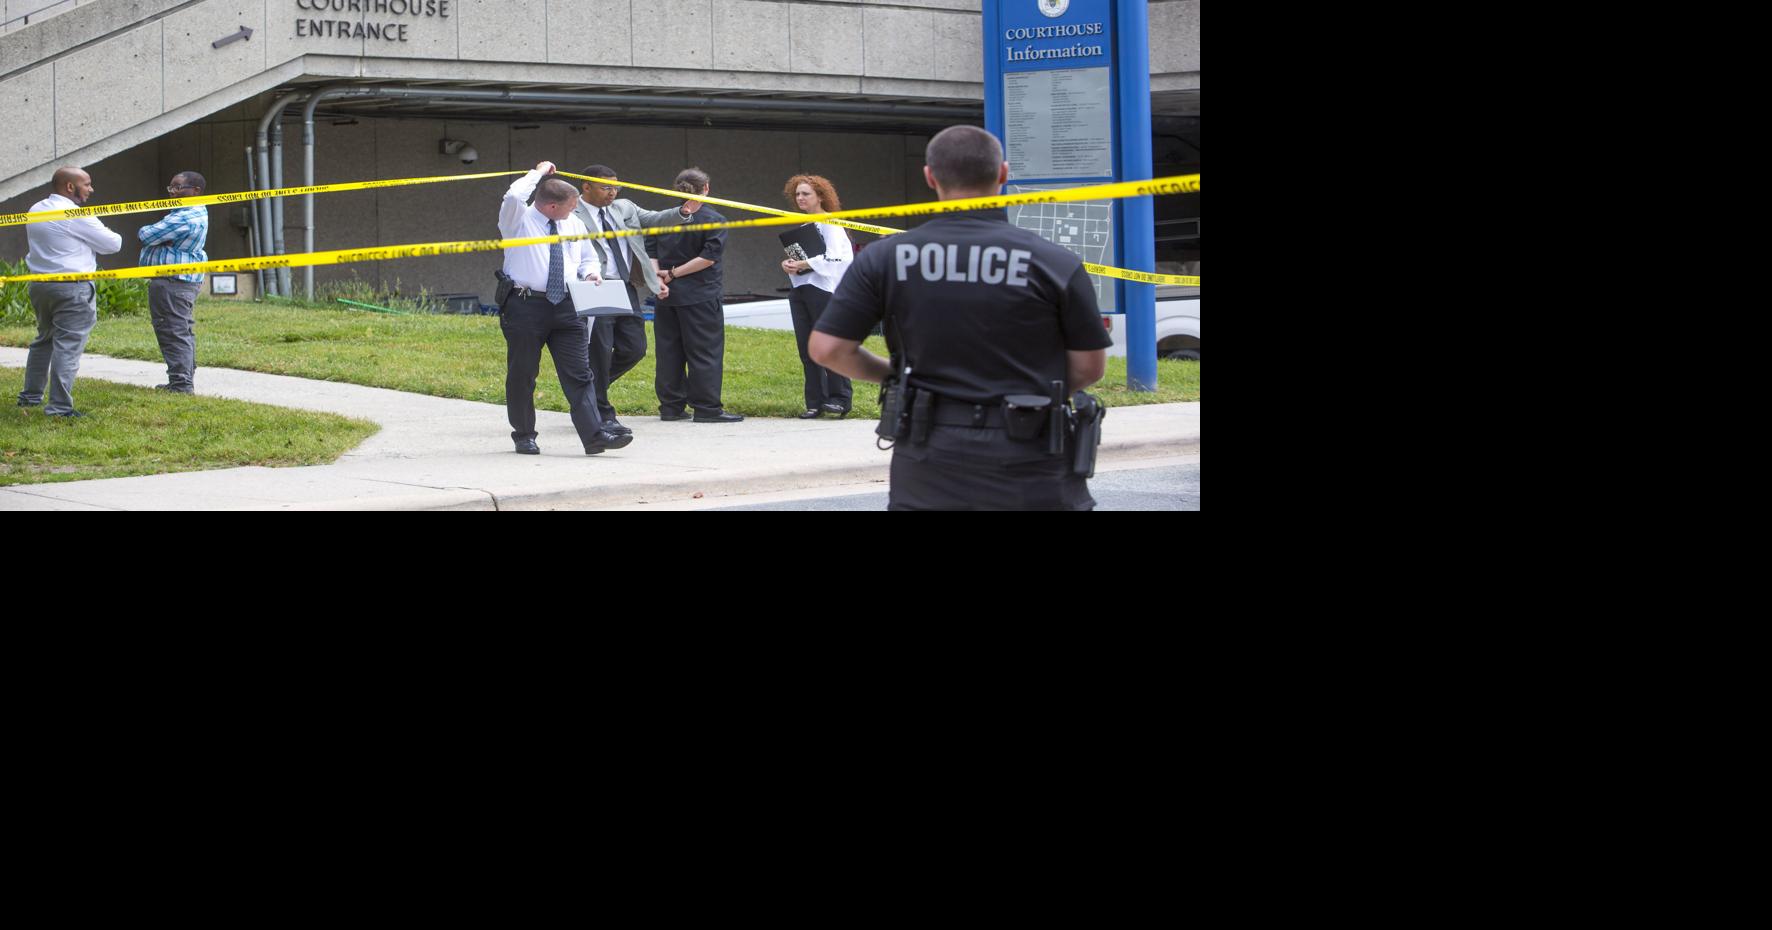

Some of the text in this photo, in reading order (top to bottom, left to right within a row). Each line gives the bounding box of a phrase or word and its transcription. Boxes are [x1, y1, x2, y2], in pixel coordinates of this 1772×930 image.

[296, 19, 408, 42] ENTRANCE
[1005, 23, 1103, 40] COURTHOUSE
[1006, 43, 1103, 61] Information
[64, 208, 91, 218] CROSS
[93, 206, 107, 215] NOT
[110, 205, 122, 214] DO
[125, 203, 142, 212] LINE
[896, 242, 1032, 287] POLICE
